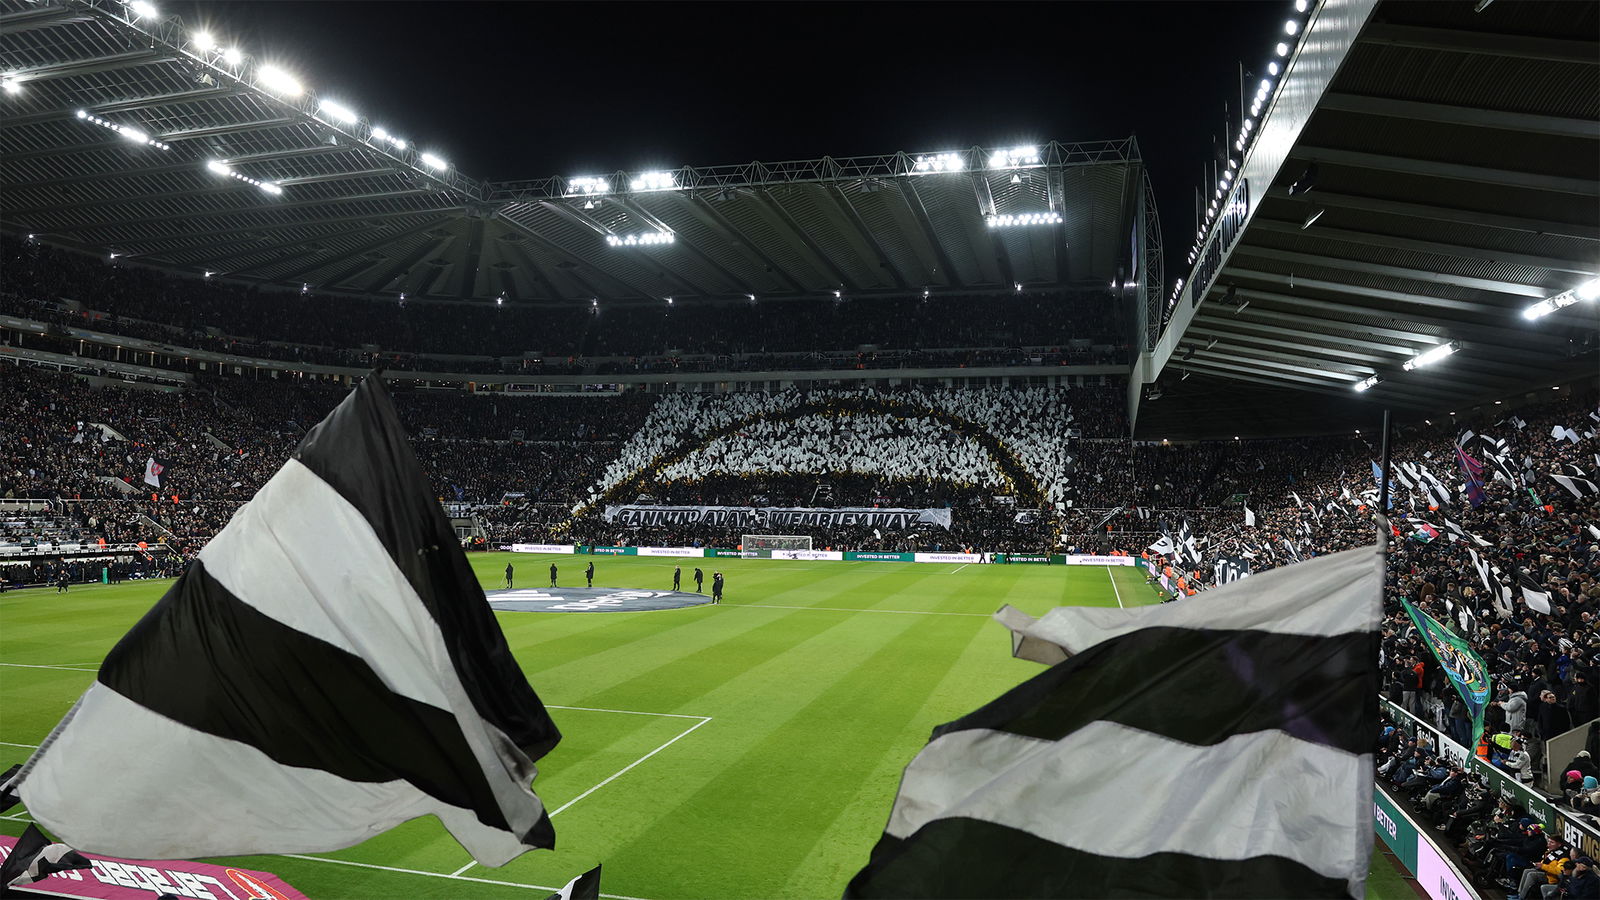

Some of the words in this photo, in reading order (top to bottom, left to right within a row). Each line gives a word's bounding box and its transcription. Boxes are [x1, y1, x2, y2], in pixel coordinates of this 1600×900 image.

[770, 512, 870, 528] WEMBLEY
[1376, 804, 1397, 841] BETTER
[1564, 820, 1600, 863] BETMG
